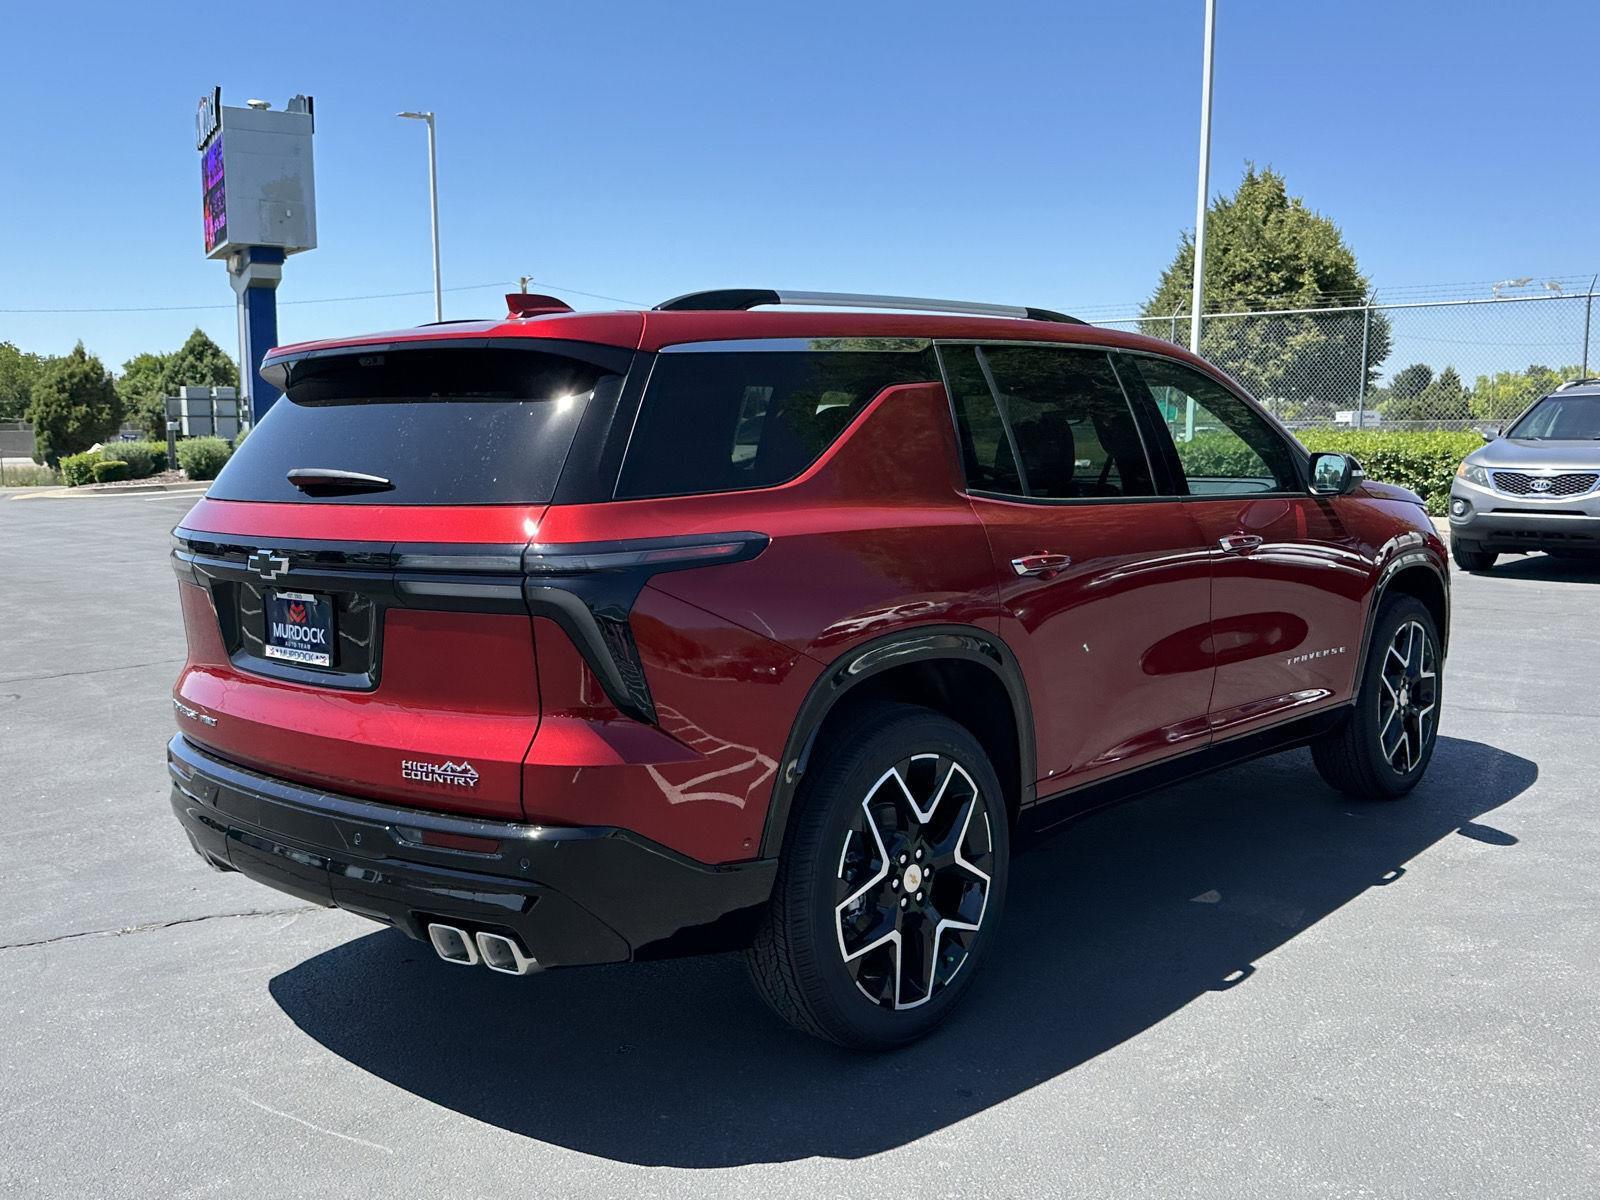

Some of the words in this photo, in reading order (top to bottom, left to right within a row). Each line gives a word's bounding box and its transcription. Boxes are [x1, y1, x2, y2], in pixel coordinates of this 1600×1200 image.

[273, 622, 326, 644] MURDOCK
[280, 648, 314, 662] MURDOCK
[1287, 646, 1346, 666] TRAVERSE
[401, 760, 439, 773] HIGH
[402, 769, 478, 787] COUNTRY
